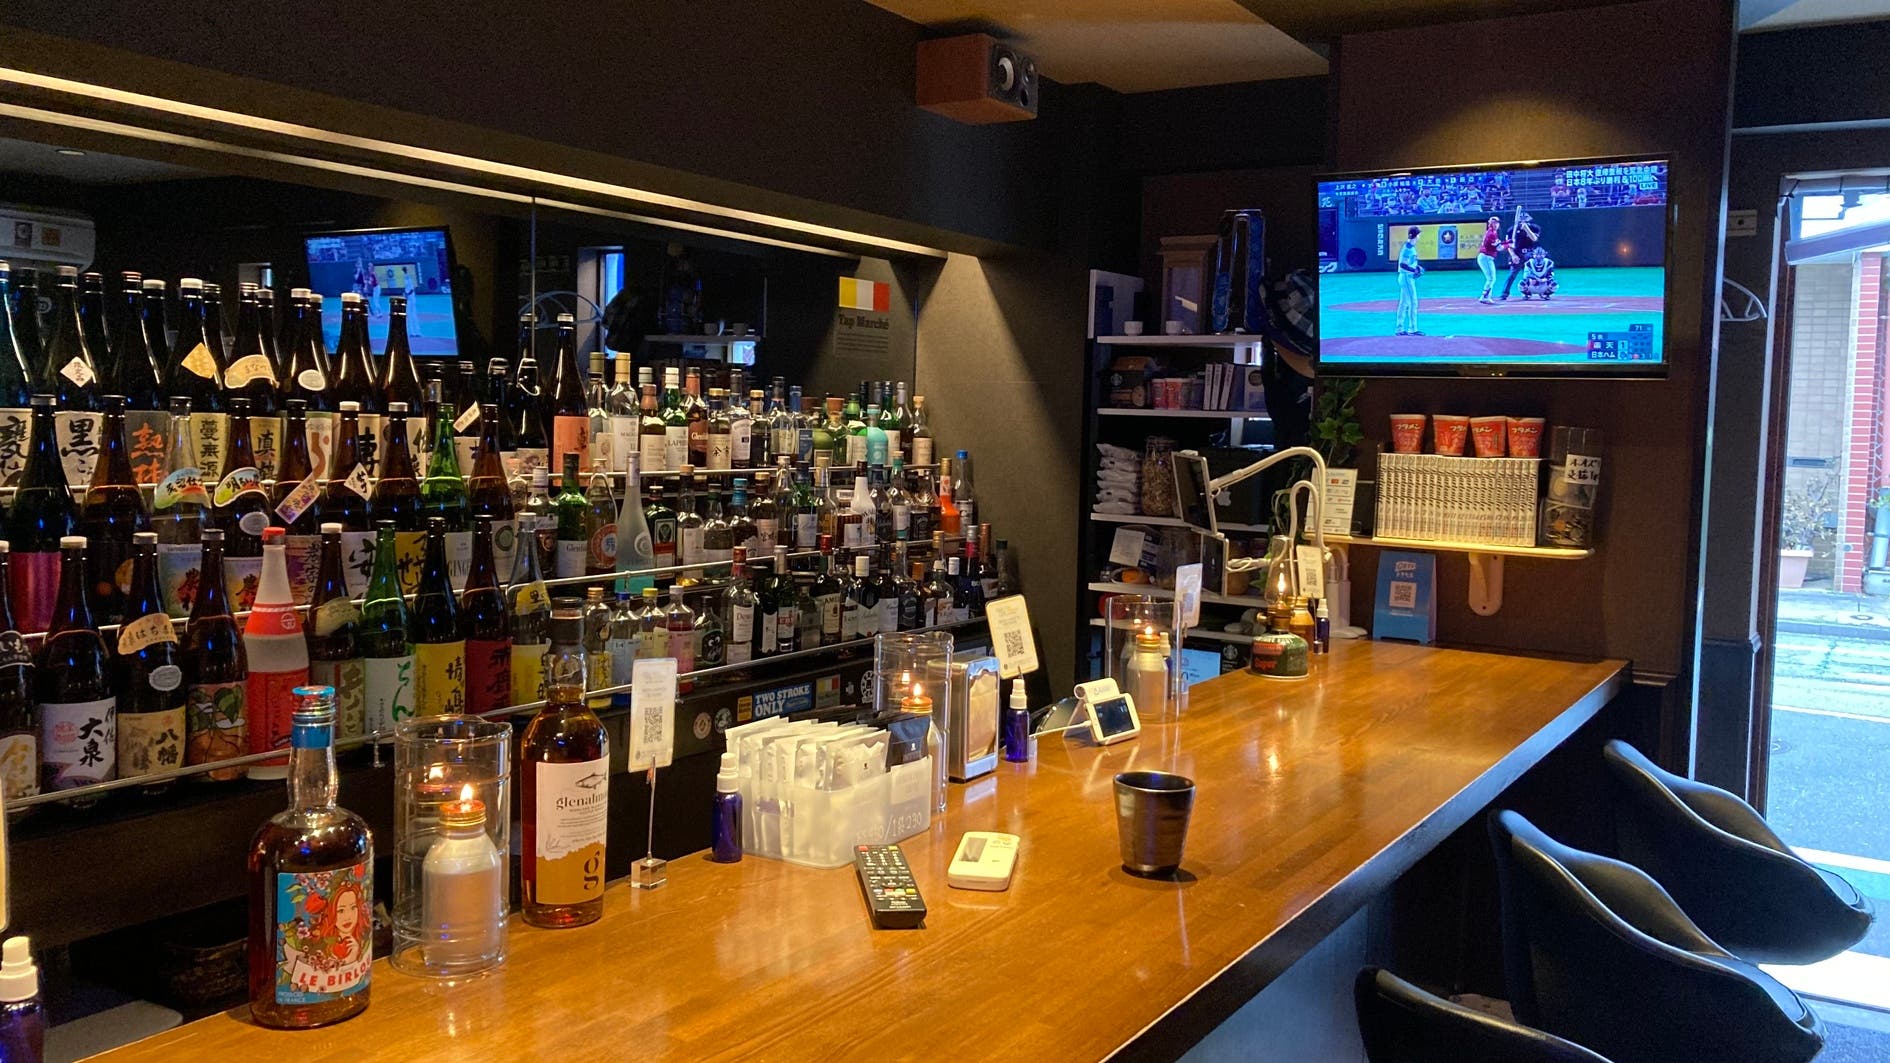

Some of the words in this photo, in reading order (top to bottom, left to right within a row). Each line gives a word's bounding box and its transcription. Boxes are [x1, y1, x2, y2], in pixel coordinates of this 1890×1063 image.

[755, 693, 775, 705] TWO
[776, 685, 810, 700] STROKE
[755, 700, 785, 718] ONLY
[77, 717, 105, 768] 大泉
[155, 728, 179, 766] 八幡
[299, 972, 318, 986] LE
